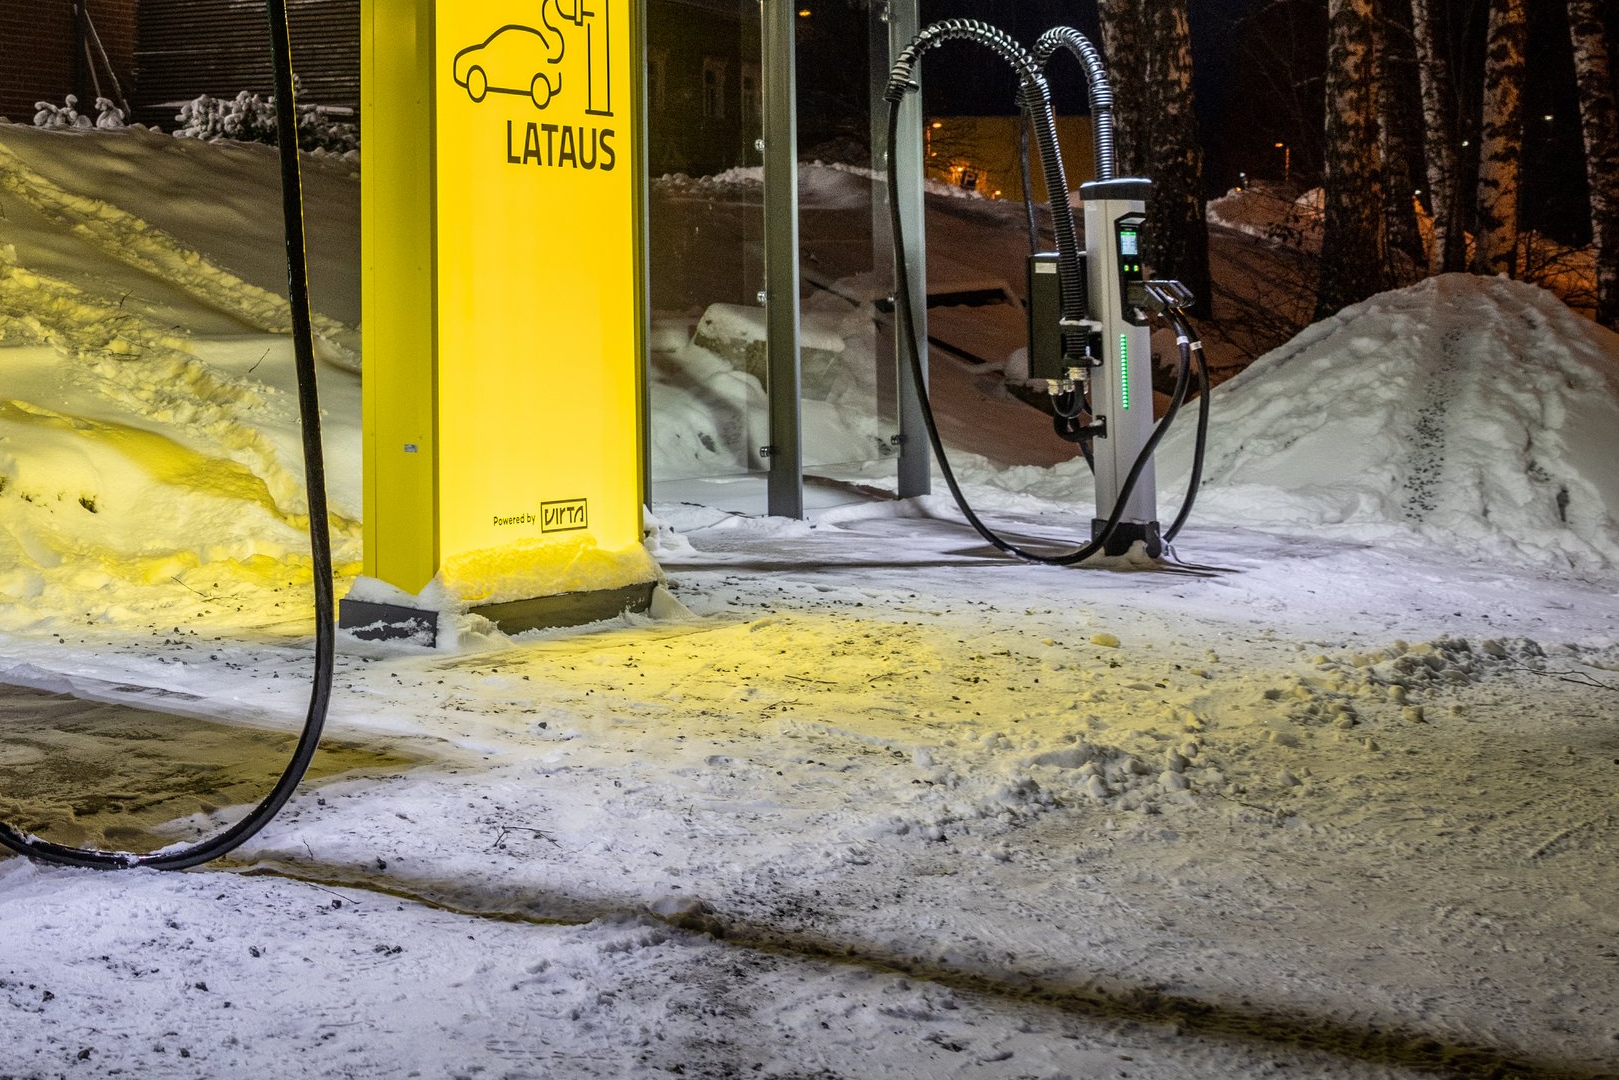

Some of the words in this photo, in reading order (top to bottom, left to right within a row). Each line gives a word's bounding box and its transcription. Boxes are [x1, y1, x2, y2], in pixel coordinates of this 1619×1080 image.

[506, 120, 616, 172] LATAUS
[493, 513, 525, 527] Powered
[526, 512, 536, 526] by
